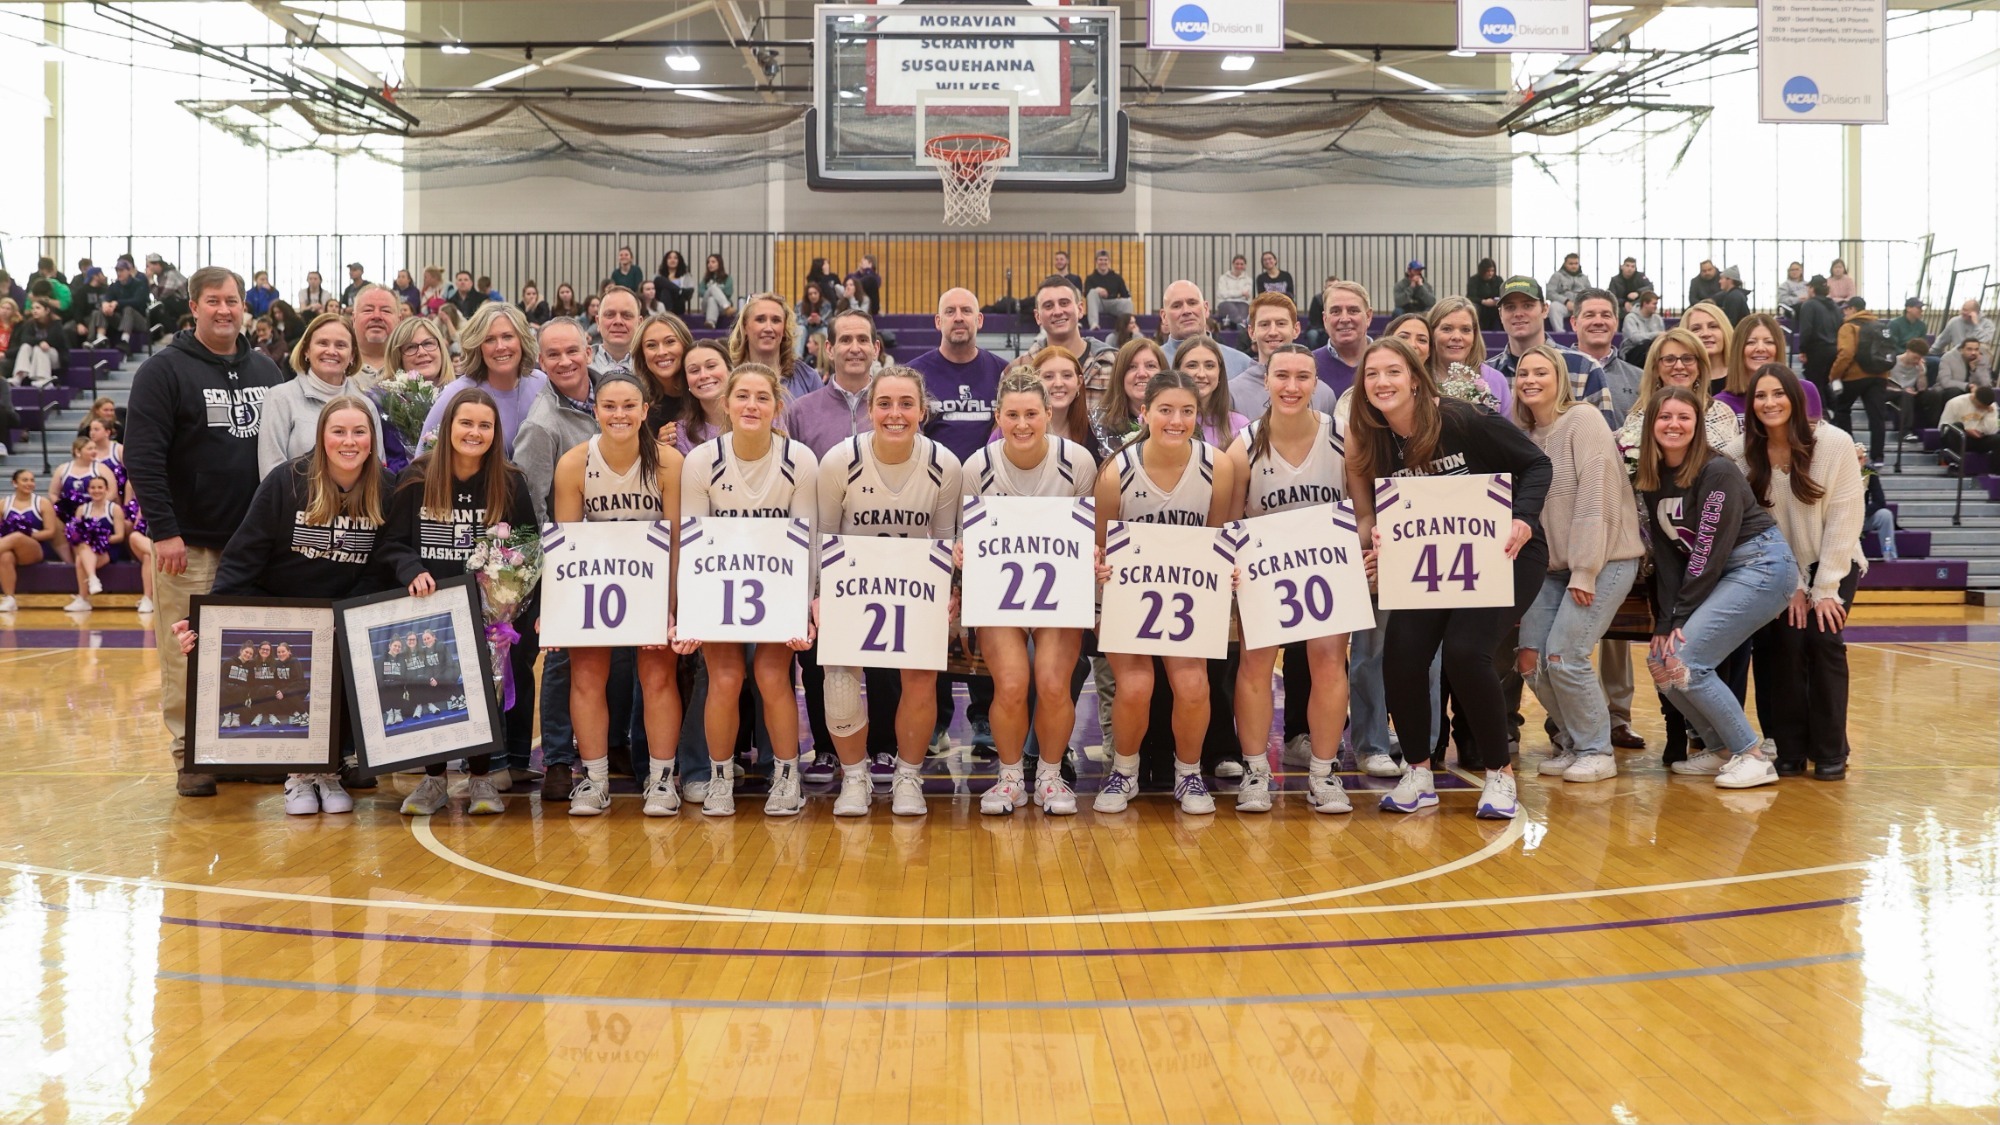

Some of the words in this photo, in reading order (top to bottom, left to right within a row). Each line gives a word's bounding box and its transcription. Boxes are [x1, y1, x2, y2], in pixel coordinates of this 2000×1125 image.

[920, 16, 1016, 27] MORAVIAN
[1174, 21, 1209, 33] NCAA
[1212, 22, 1252, 34] Division
[1255, 24, 1263, 33] III
[1482, 24, 1515, 35] NCAA
[1519, 24, 1558, 35] Division
[1561, 25, 1569, 35] III
[921, 39, 1015, 49] SCRANTON
[901, 59, 1035, 73] SUSQUEHANNA
[1786, 93, 1819, 104] NCAA
[1821, 94, 1861, 104] Division
[1863, 95, 1871, 104] III
[929, 399, 998, 413] ROYALS
[585, 493, 663, 513] SCRANTON
[1261, 485, 1341, 511] SCRANTON
[853, 509, 931, 526] SCRANTON
[1392, 516, 1497, 542] SCRANTON
[1687, 490, 1726, 577] SCRANTON
[978, 536, 1080, 560] SCRANTON
[556, 558, 654, 582] SCRANTON
[694, 553, 794, 577] SCRANTON
[1248, 546, 1349, 582] SCRANTON
[1410, 542, 1480, 593] 44
[835, 577, 936, 603] SCRANTON
[997, 561, 1060, 611] 22
[1119, 565, 1219, 592] SCRANTON
[581, 583, 627, 630] 10
[719, 578, 766, 626] 13
[1273, 574, 1335, 629] 30
[860, 602, 907, 653] 21
[1135, 590, 1195, 642] 23
